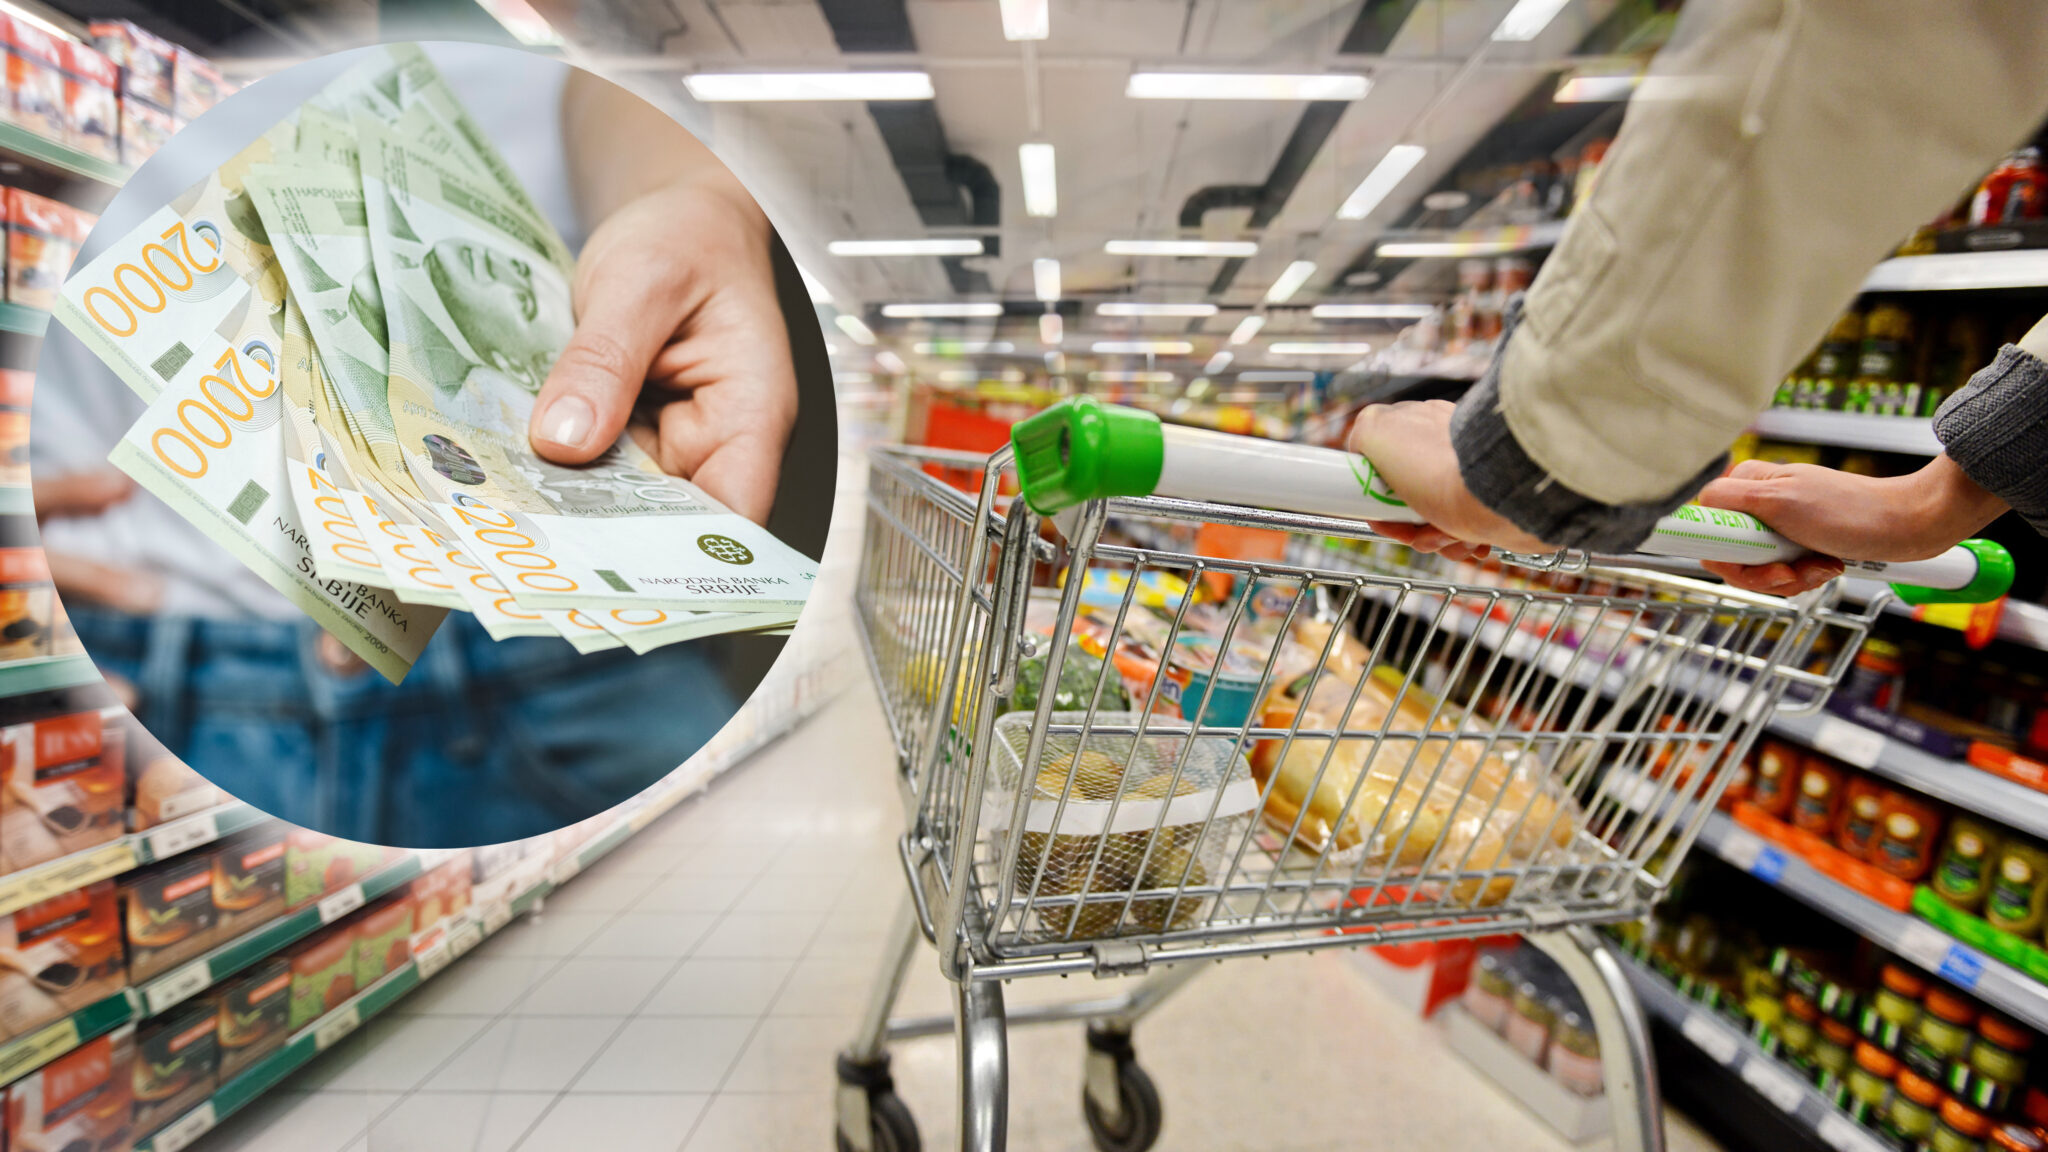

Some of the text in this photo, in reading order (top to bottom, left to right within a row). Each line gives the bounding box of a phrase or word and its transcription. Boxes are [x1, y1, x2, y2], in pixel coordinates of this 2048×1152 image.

[83, 221, 219, 338] 2000
[152, 346, 275, 480] 2000
[452, 503, 579, 592] 2000
[638, 577, 790, 586] NARODNA BANKA
[685, 584, 766, 596] SRBIJE
[355, 584, 408, 633] BANKA
[364, 632, 389, 655] 2000
